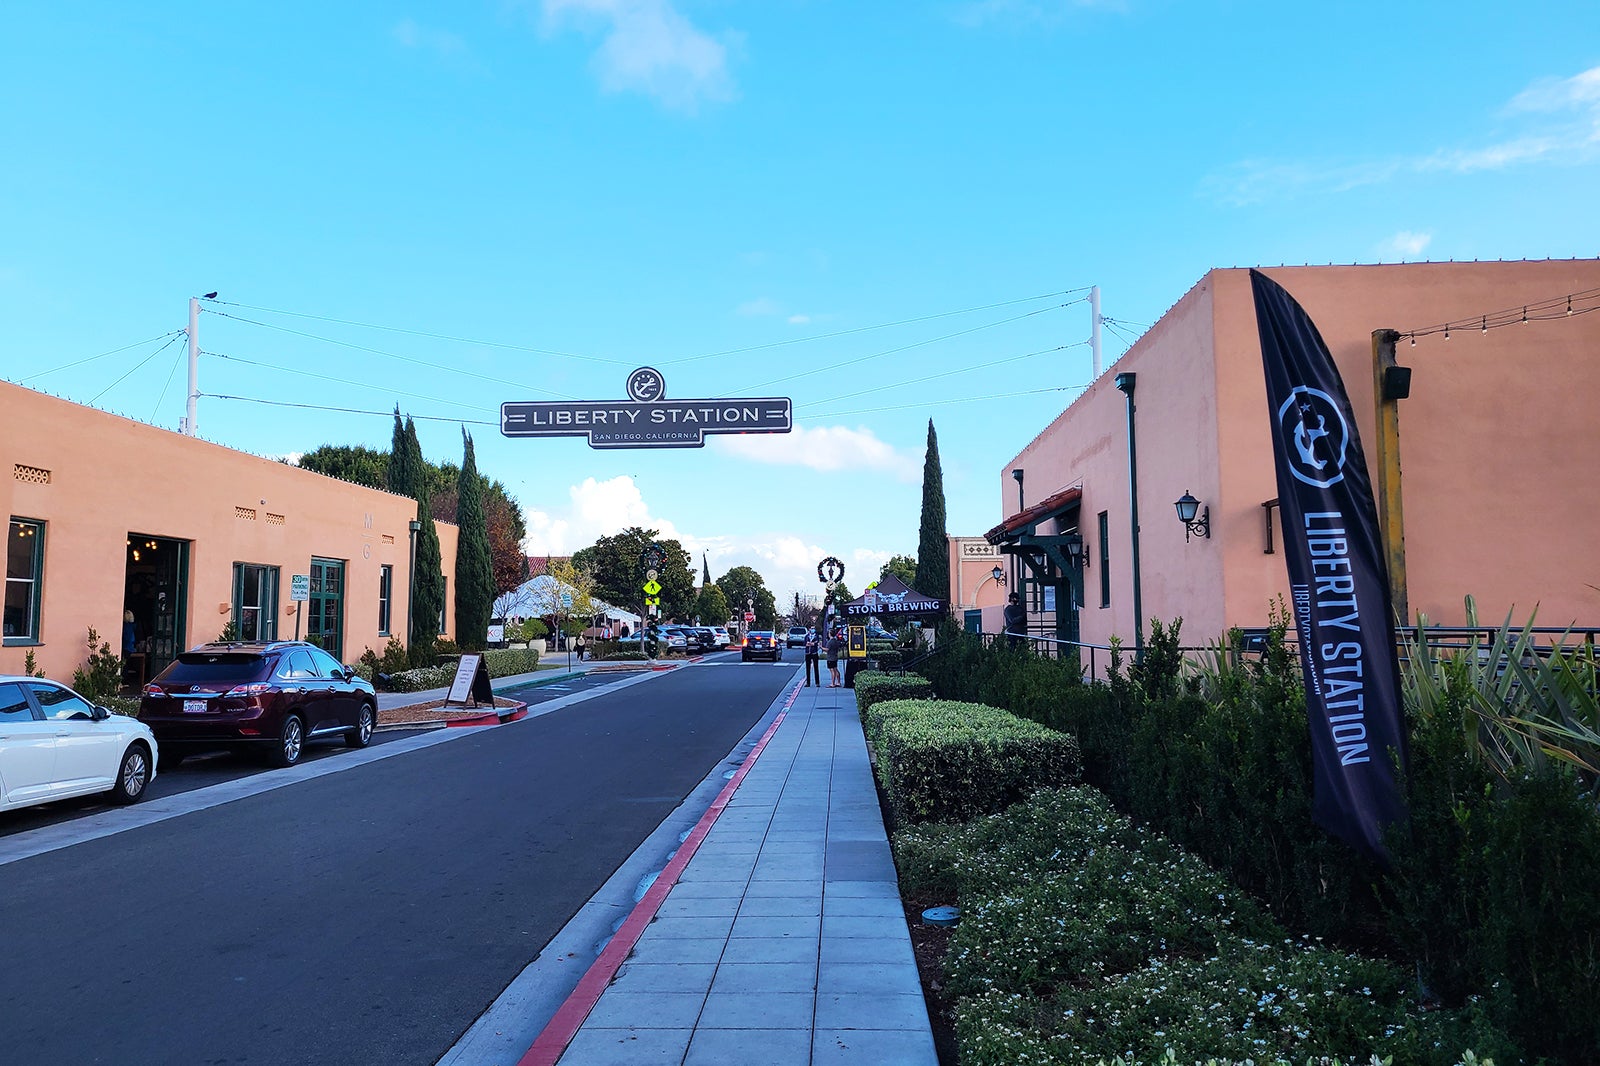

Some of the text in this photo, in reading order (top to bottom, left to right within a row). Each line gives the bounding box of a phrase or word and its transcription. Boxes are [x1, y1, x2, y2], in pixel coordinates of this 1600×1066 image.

[533, 407, 759, 425] LIBERTY STATION
[645, 432, 698, 440] CALIFORNIA
[848, 601, 939, 614] STONE BREWING
[1304, 511, 1370, 767] LIBERTY STATION
